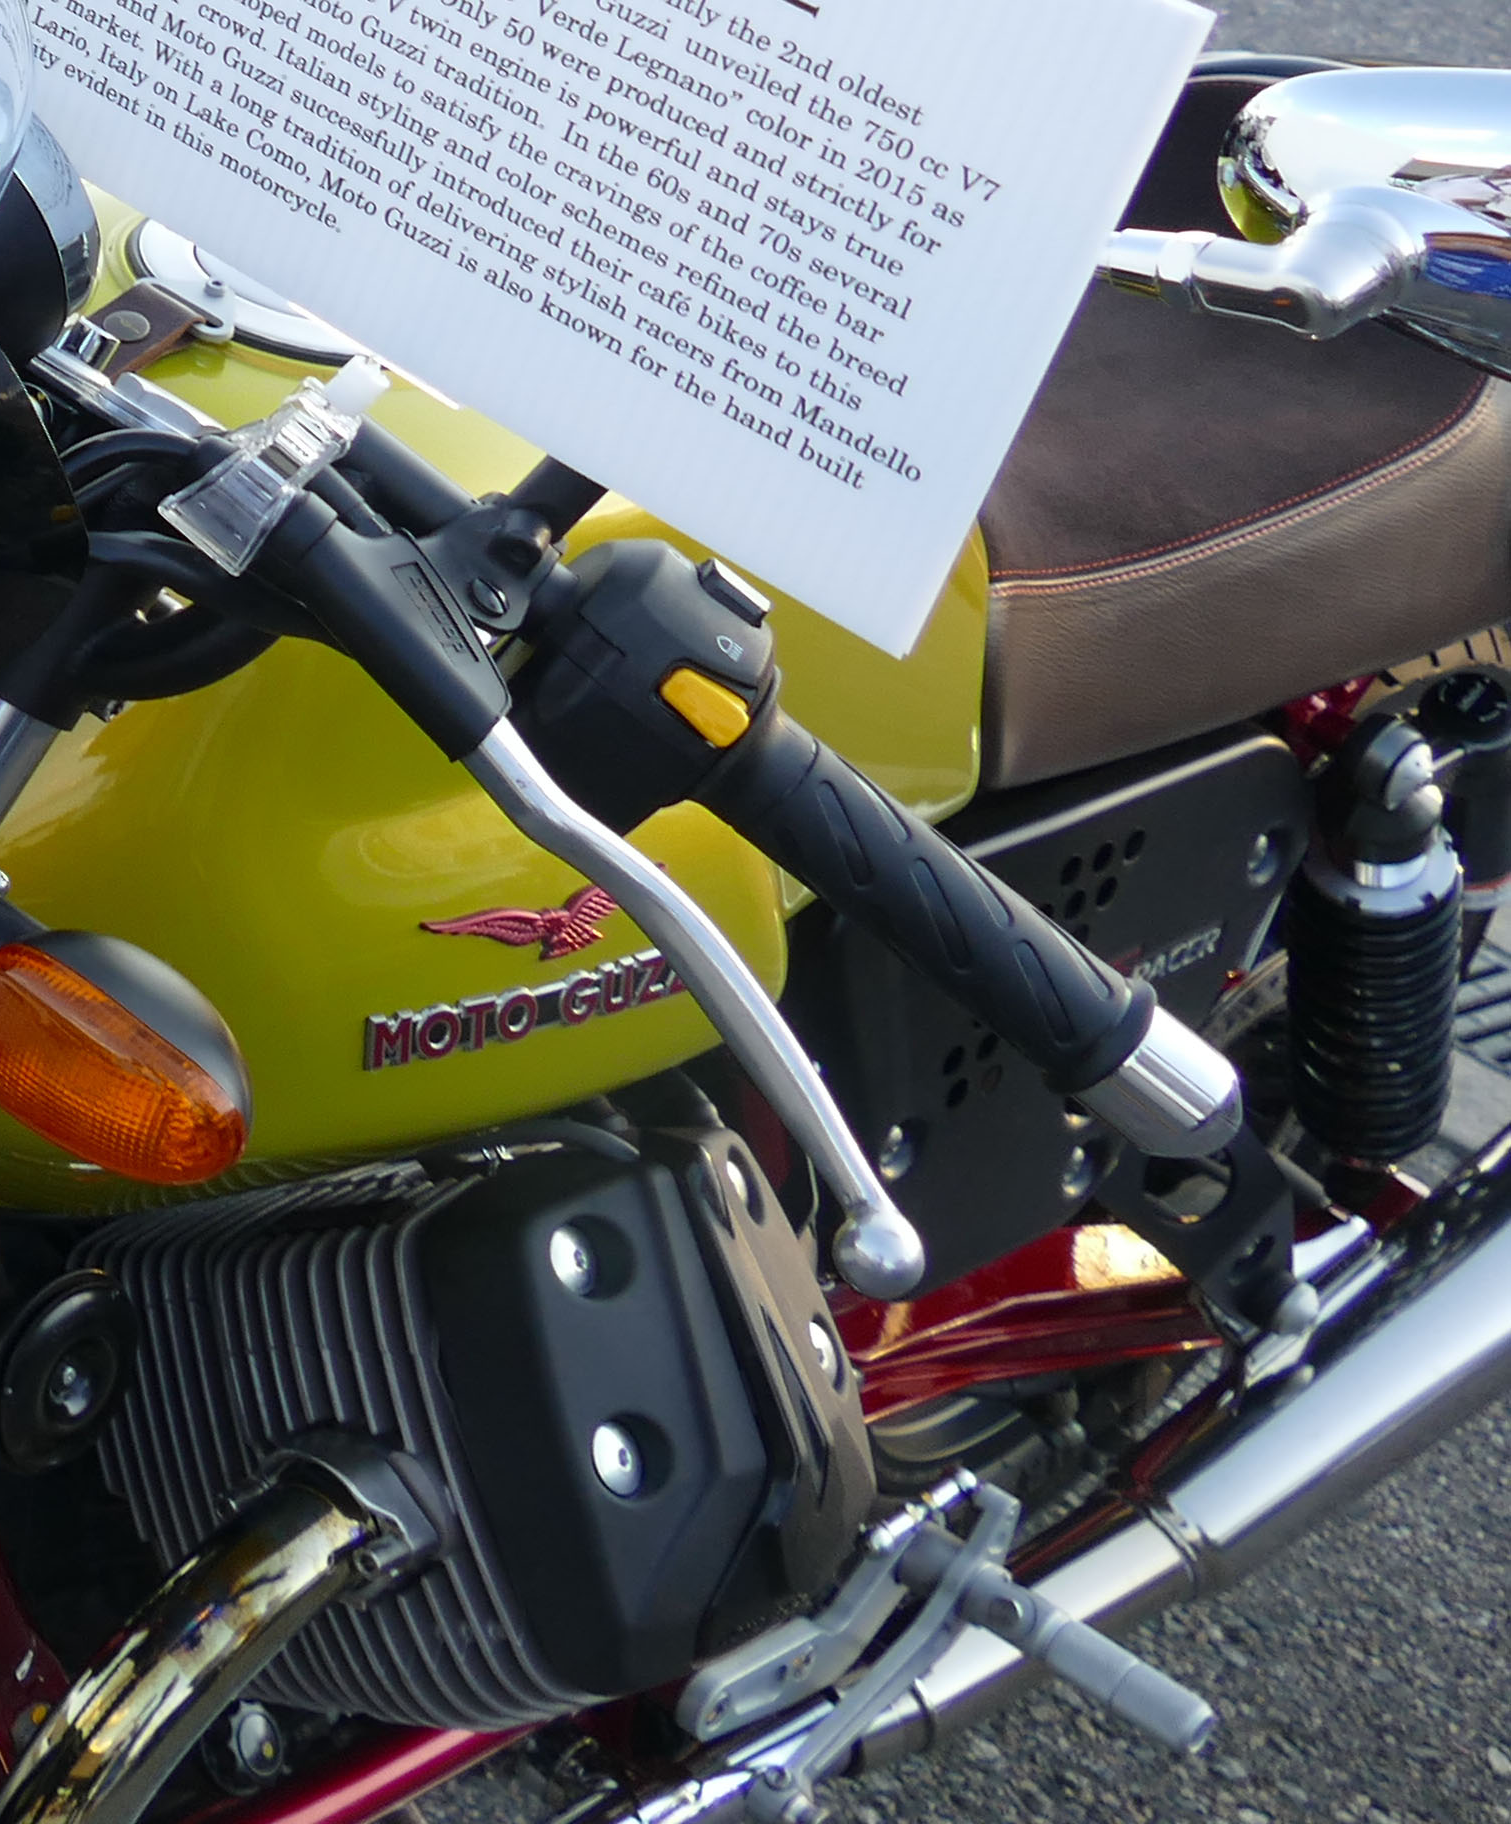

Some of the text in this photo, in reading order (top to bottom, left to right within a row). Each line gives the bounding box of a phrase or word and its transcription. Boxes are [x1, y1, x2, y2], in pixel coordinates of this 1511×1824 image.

[63, 63, 141, 116] evident
[143, 102, 166, 132] in
[172, 120, 214, 158] this
[218, 151, 341, 233] motorcycle.
[197, 3, 267, 52] crowd.
[272, 38, 351, 98] Italian
[356, 90, 441, 148] styling
[442, 137, 492, 173] and
[495, 165, 557, 207] color
[560, 201, 669, 268] schemes
[673, 261, 771, 324] refined
[775, 312, 821, 350] the
[826, 335, 909, 397] breed
[303, 25, 387, 80] models
[419, 88, 503, 142] satisfy
[507, 130, 548, 166] the
[553, 160, 663, 228] cravings
[700, 233, 744, 270] the
[749, 265, 828, 316] coffee
[834, 301, 885, 344] bar
[359, 14, 429, 67] Guzzi
[433, 54, 545, 130] tradition.
[560, 119, 589, 153] In
[596, 141, 639, 177] the
[645, 166, 691, 205] 60s
[696, 198, 751, 236] and
[758, 223, 802, 264] 70s
[807, 256, 912, 321] several
[408, 5, 463, 49] twin
[468, 41, 552, 94] engine
[582, 101, 702, 173] powerful
[705, 164, 760, 203] and
[762, 195, 837, 242] stays
[844, 231, 904, 277] true
[502, 16, 535, 47] 50
[541, 39, 601, 82] were
[602, 74, 730, 148] produced
[732, 140, 788, 178] and
[790, 170, 894, 232] strictly
[897, 218, 942, 255] for
[684, 36, 802, 107] unveiled
[807, 94, 853, 132] the
[863, 119, 914, 161] 750
[918, 155, 949, 180] cc
[961, 164, 1001, 202] V7
[726, 15, 771, 52] the
[776, 39, 833, 83] 2nd
[837, 74, 923, 126] oldest
[745, 108, 813, 151] color
[817, 137, 847, 171] in
[853, 157, 926, 207] 2015
[930, 201, 965, 228] as
[30, 4, 864, 490] Lario, Italy on Lake Como, Moto Guzzi also known for the hand built
[154, 38, 204, 86] With
[228, 81, 279, 129] long
[282, 114, 382, 186] tradition
[415, 189, 540, 275] delivering
[541, 264, 627, 322] stylish
[632, 313, 715, 369] racers
[719, 357, 783, 409] from
[789, 394, 921, 482] Mandello
[159, 10, 216, 56] Moto
[221, 45, 287, 97] Guzzi
[289, 88, 429, 174] successfully
[430, 160, 565, 249] introduced
[569, 237, 634, 285] their
[637, 280, 693, 318] café
[696, 303, 768, 360] bikes
[808, 368, 862, 411] this
[364, 947, 686, 1071] MOTO GUZ
